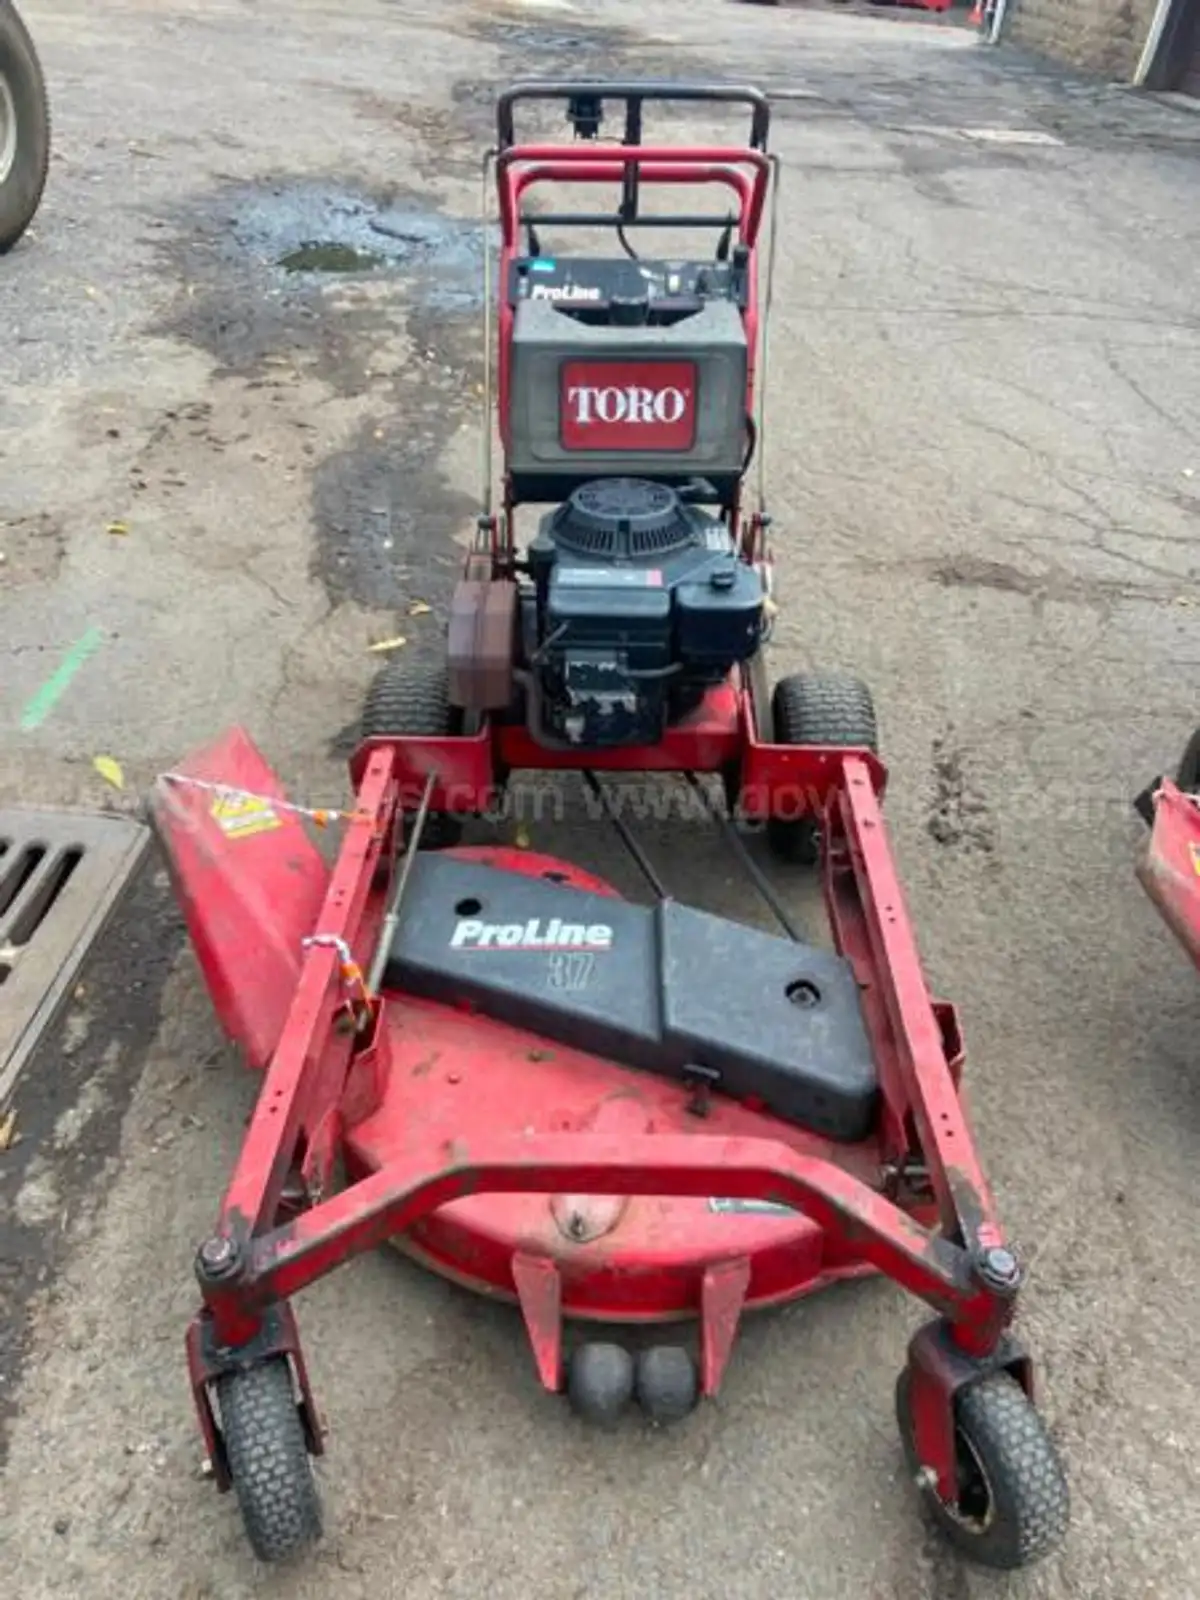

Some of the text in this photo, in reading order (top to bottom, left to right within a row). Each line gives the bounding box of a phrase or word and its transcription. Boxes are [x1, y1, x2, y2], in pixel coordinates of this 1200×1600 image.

[531, 282, 601, 300] ProLine
[568, 386, 686, 424] TORO
[449, 917, 614, 949] ProLine
